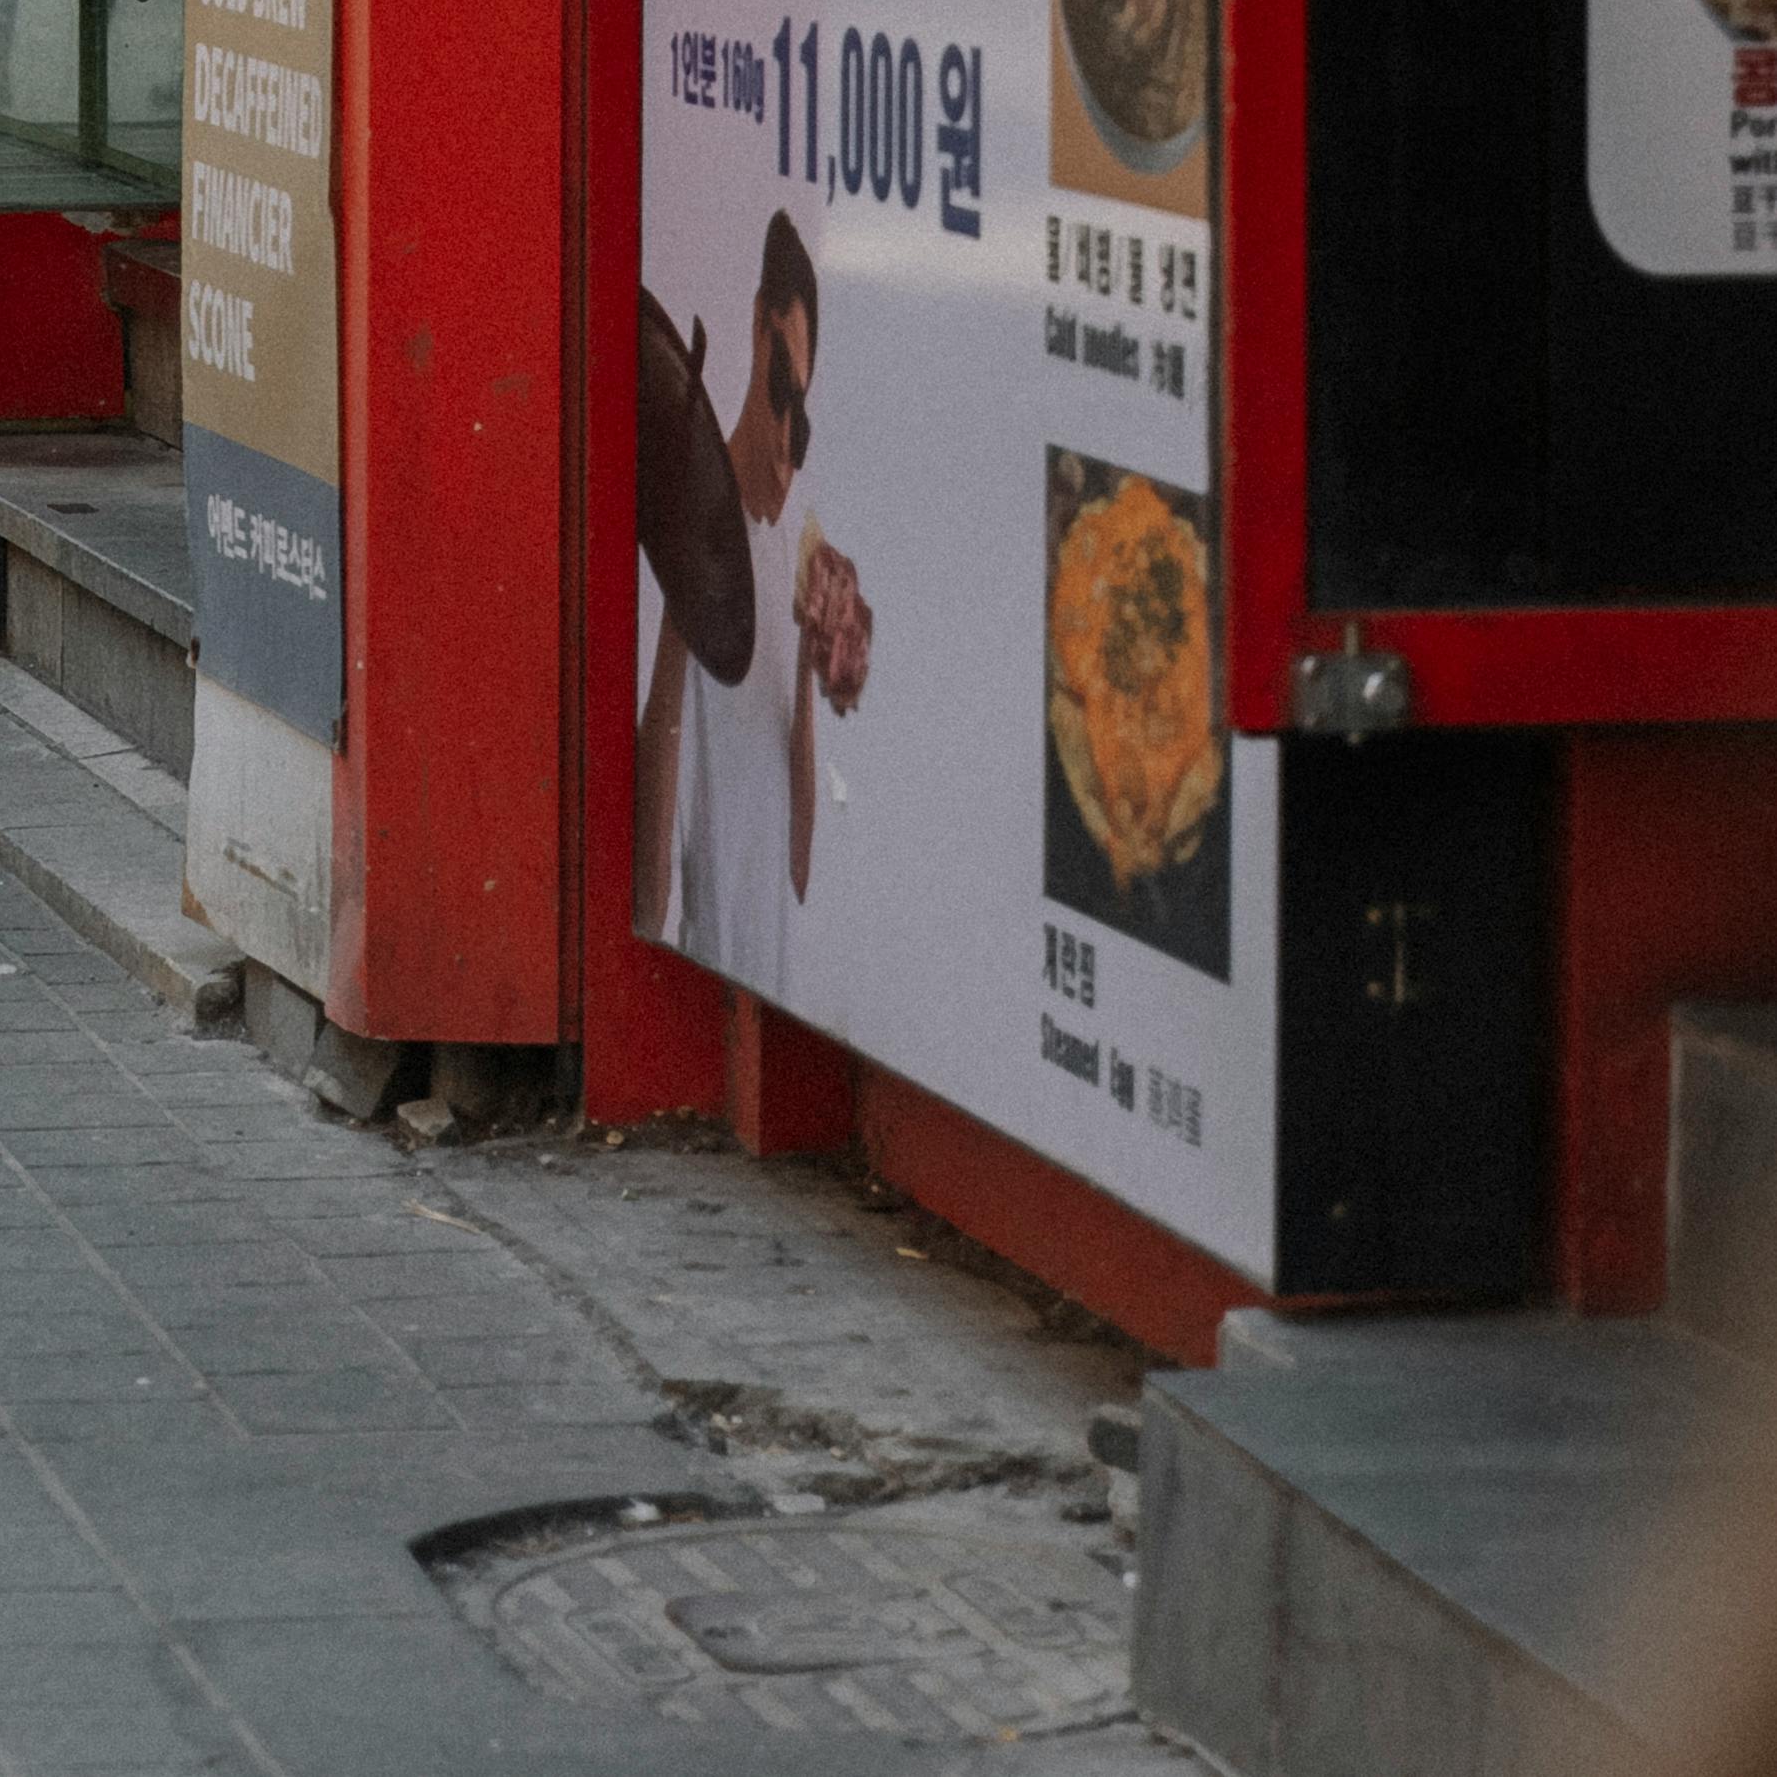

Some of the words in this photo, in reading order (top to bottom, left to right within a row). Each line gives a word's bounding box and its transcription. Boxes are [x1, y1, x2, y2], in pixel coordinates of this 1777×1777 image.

[194, 42, 322, 159] DECAFFEINED
[192, 160, 294, 275] FINANCIER
[188, 278, 255, 383] SCONE
